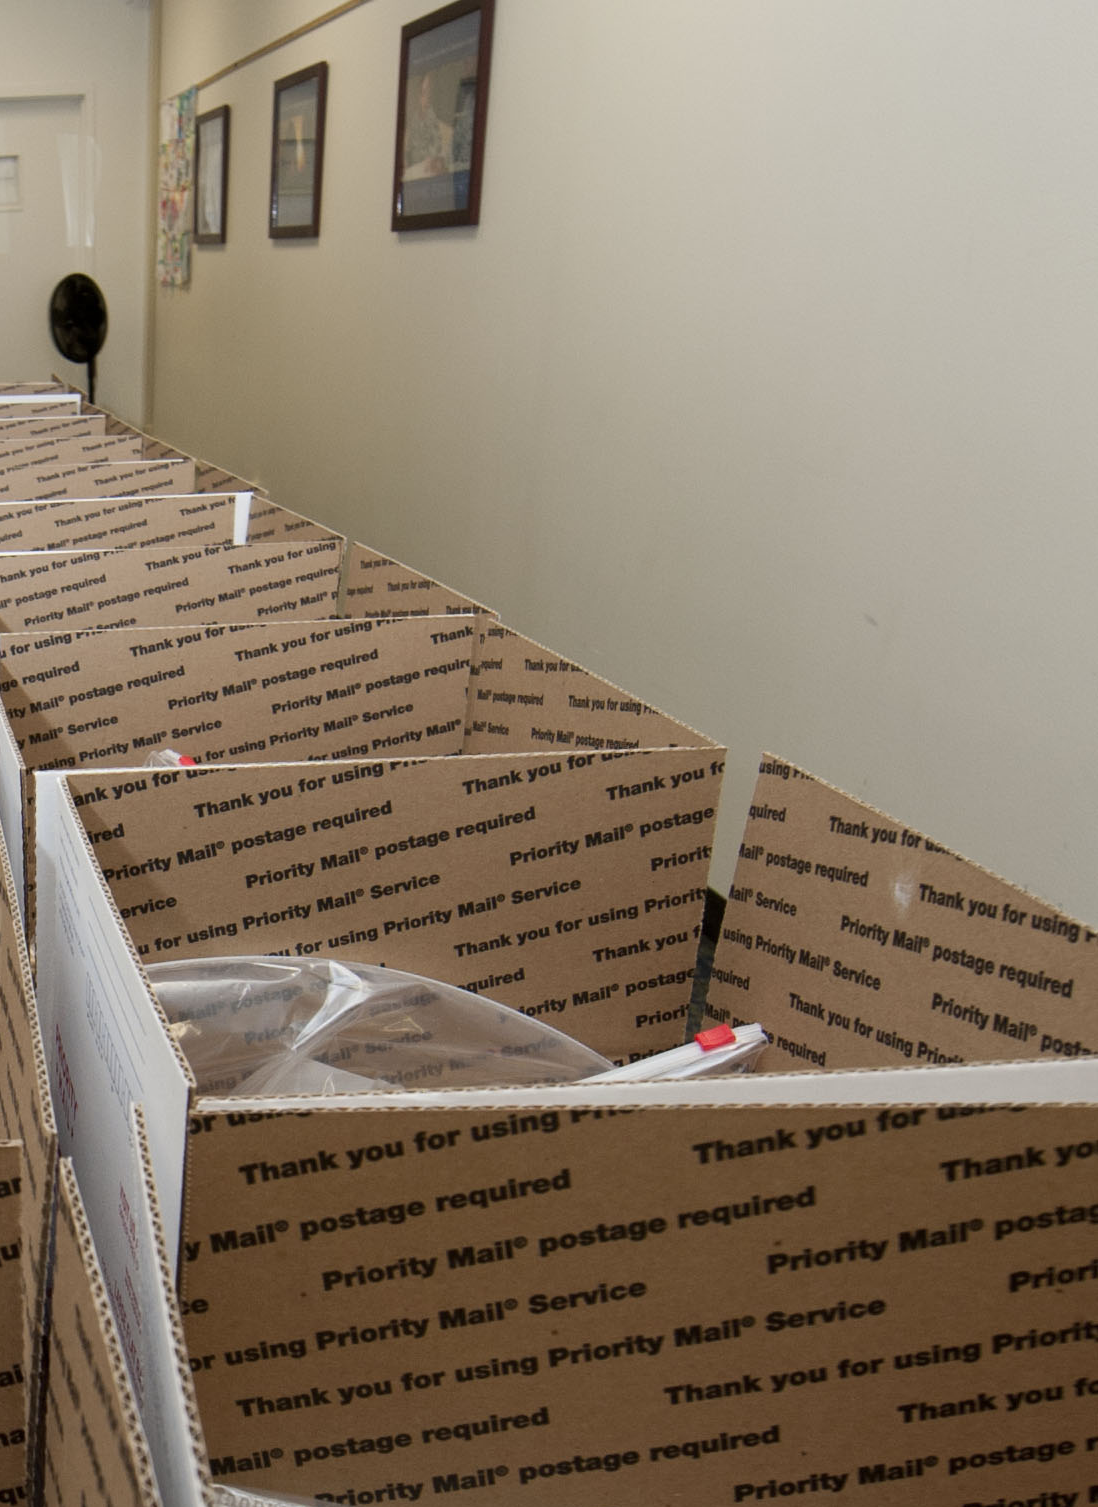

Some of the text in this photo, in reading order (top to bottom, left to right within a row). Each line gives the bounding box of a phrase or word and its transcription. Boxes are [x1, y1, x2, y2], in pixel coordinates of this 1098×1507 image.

[54, 501, 143, 527] Thank you for using
[168, 691, 218, 710] Priority
[262, 667, 316, 689] postage
[320, 649, 378, 672] required
[569, 695, 642, 716] Thank you for using
[246, 863, 315, 888] Priority
[375, 831, 450, 860] postage
[456, 806, 536, 838] required
[841, 915, 890, 946] Priority
[932, 945, 995, 975] postage
[999, 965, 1074, 998] required
[236, 1388, 331, 1417] Thank
[337, 1381, 392, 1406] you
[401, 1371, 445, 1391] for
[455, 1357, 538, 1382] using
[548, 1335, 664, 1368] Priority
[765, 1300, 886, 1332] Service
[664, 1343, 982, 1405] Thank you for using
